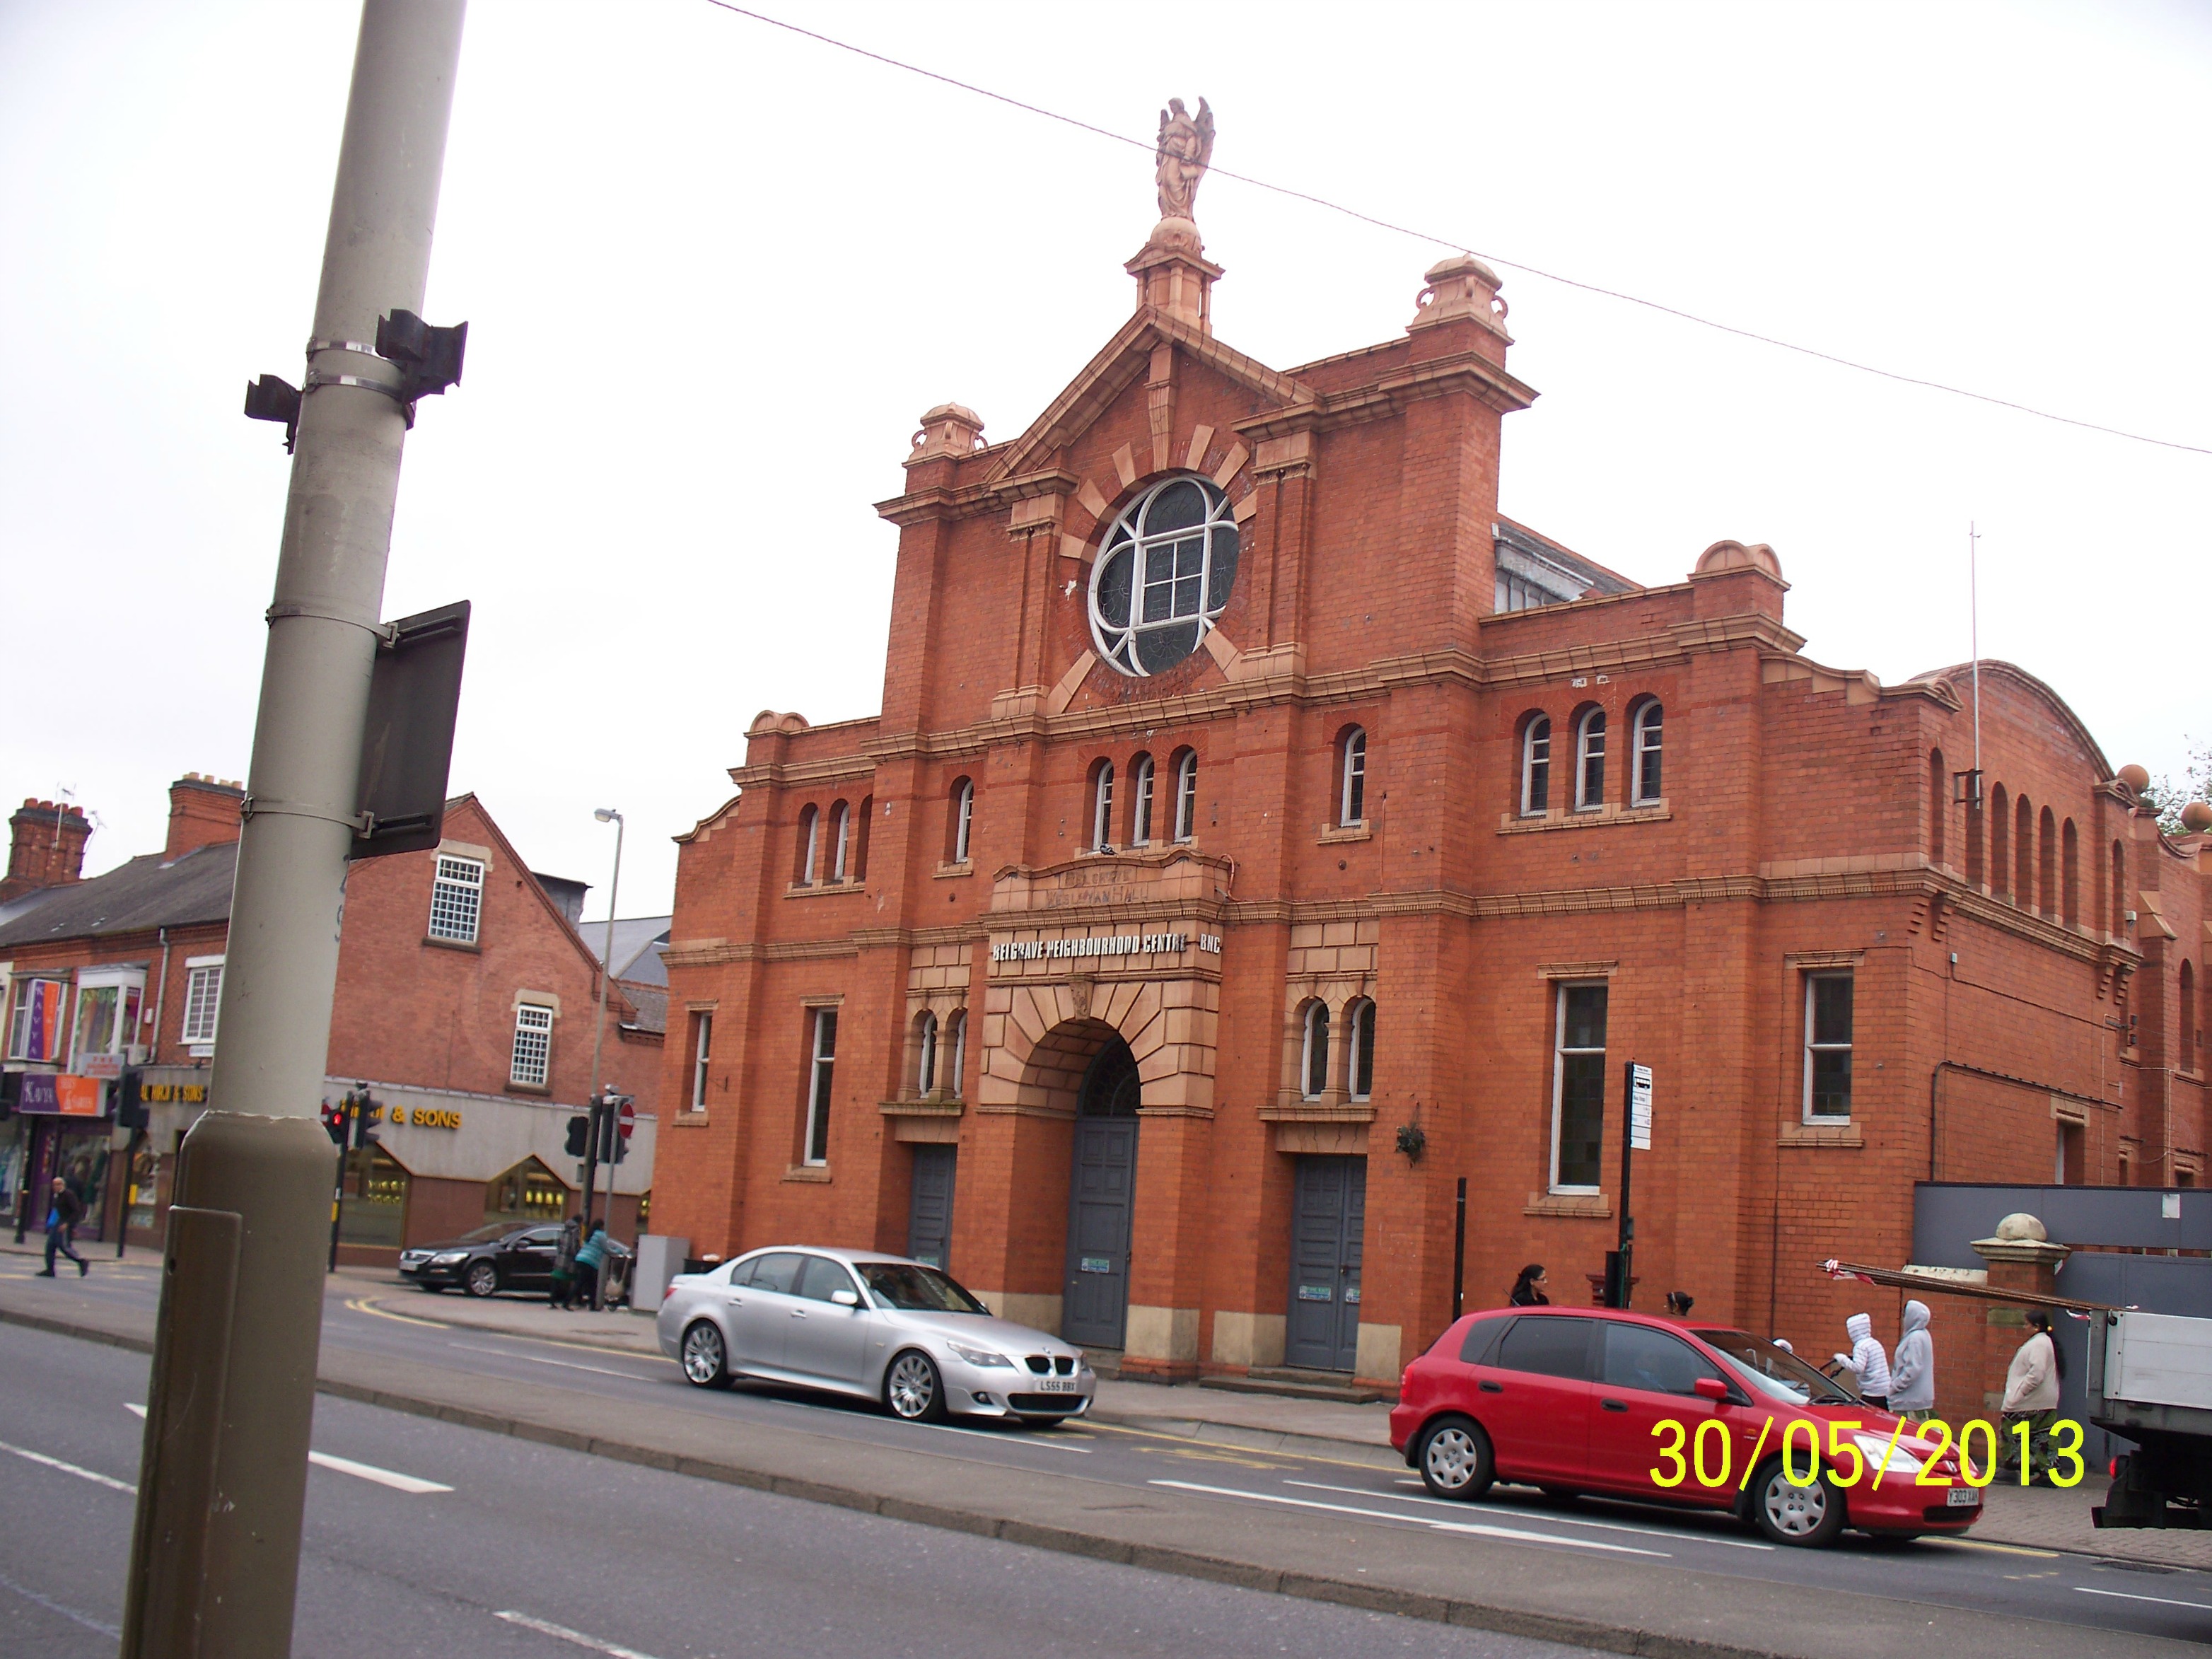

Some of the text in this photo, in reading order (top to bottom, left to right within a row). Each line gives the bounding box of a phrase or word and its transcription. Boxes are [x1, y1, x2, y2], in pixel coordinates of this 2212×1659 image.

[992, 933, 1221, 962] BELGRAVE NEIGHBOURHOOD CENTRE BNC
[182, 1085, 204, 1102] SONS
[392, 1105, 406, 1123] &
[413, 1107, 463, 1129] SONS
